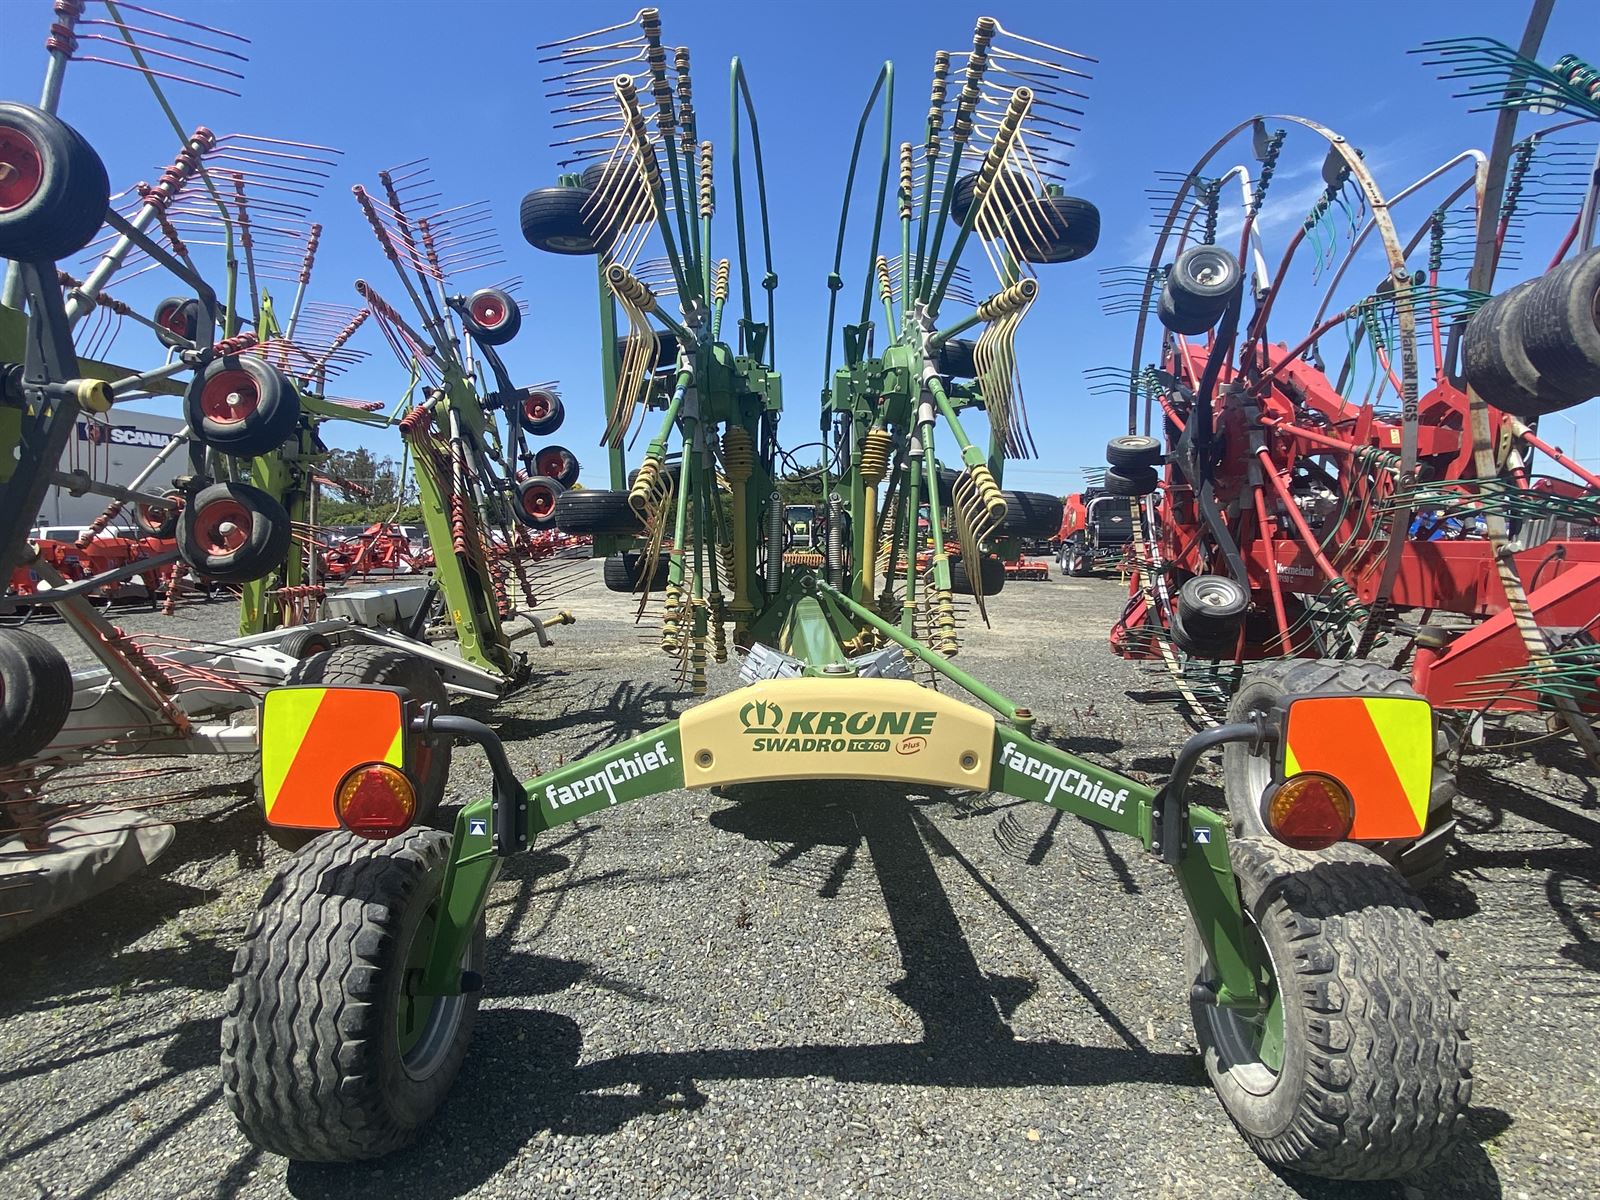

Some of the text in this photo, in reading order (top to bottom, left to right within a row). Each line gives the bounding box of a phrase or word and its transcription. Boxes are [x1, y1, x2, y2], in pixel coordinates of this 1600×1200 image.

[110, 428, 170, 447] SCANIA
[785, 711, 938, 735] KRONE
[752, 738, 920, 752] SWADRO TC 760 Plus
